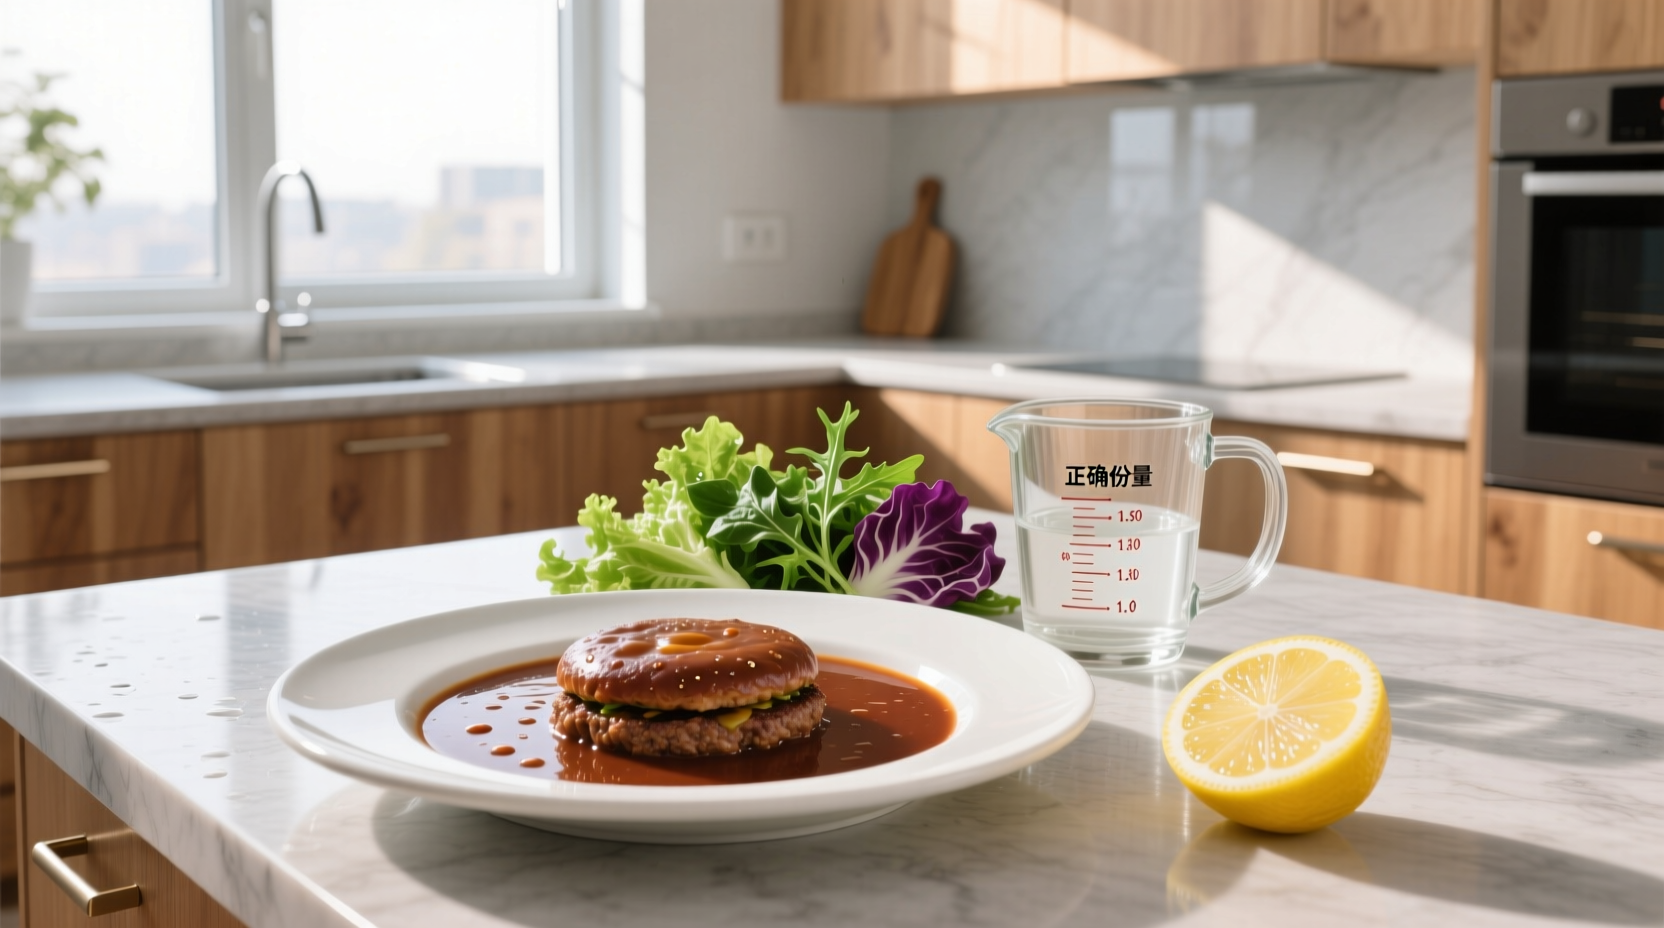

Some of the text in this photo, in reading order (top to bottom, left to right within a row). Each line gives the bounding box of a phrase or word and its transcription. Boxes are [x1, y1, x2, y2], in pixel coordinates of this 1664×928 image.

[1065, 464, 1153, 488] 正确份量
[1117, 509, 1143, 522] 1.50
[1117, 600, 1137, 613] 1.0
